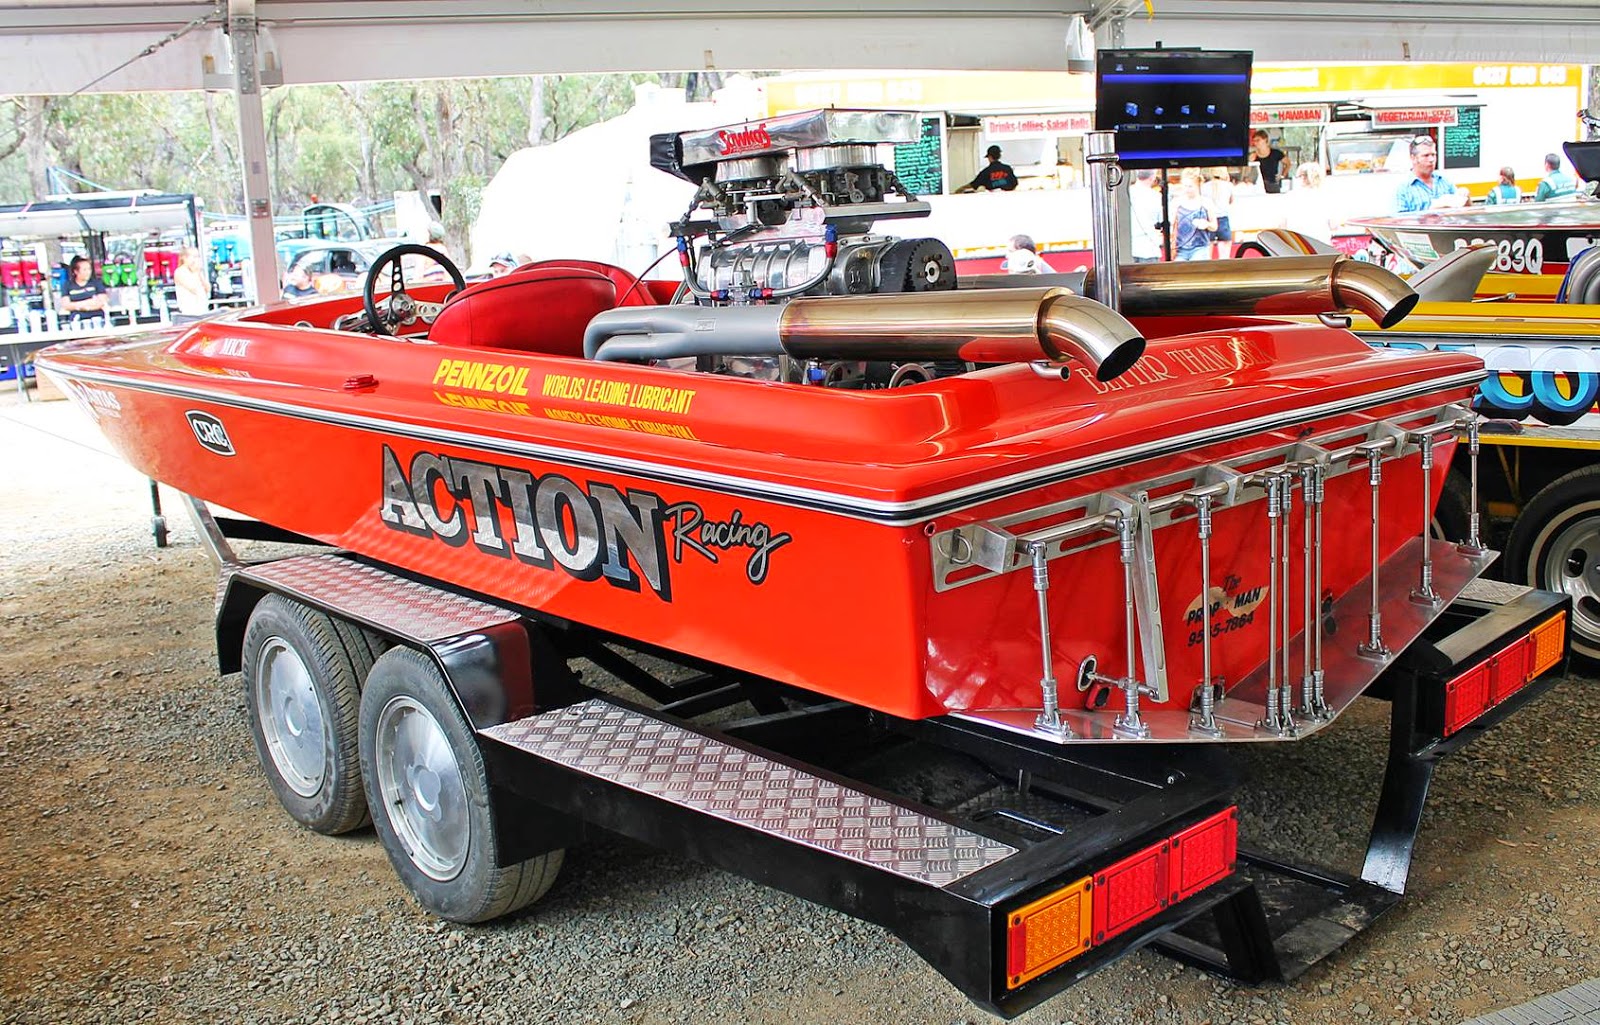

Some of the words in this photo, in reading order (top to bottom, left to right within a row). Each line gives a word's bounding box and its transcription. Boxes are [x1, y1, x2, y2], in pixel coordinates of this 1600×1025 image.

[219, 338, 251, 358] MICK
[1164, 344, 1233, 375] THAN
[432, 358, 530, 397] PENNZOIL
[542, 374, 584, 400] WORLDS
[583, 379, 630, 407] LEADING
[629, 384, 696, 415] LUBRICANT
[193, 419, 228, 447] CRC
[379, 443, 672, 603] ACTION
[664, 501, 792, 585] Racing
[1188, 602, 1220, 625] PRP
[1234, 587, 1261, 608] MAN
[1188, 613, 1253, 646] 955-7864
